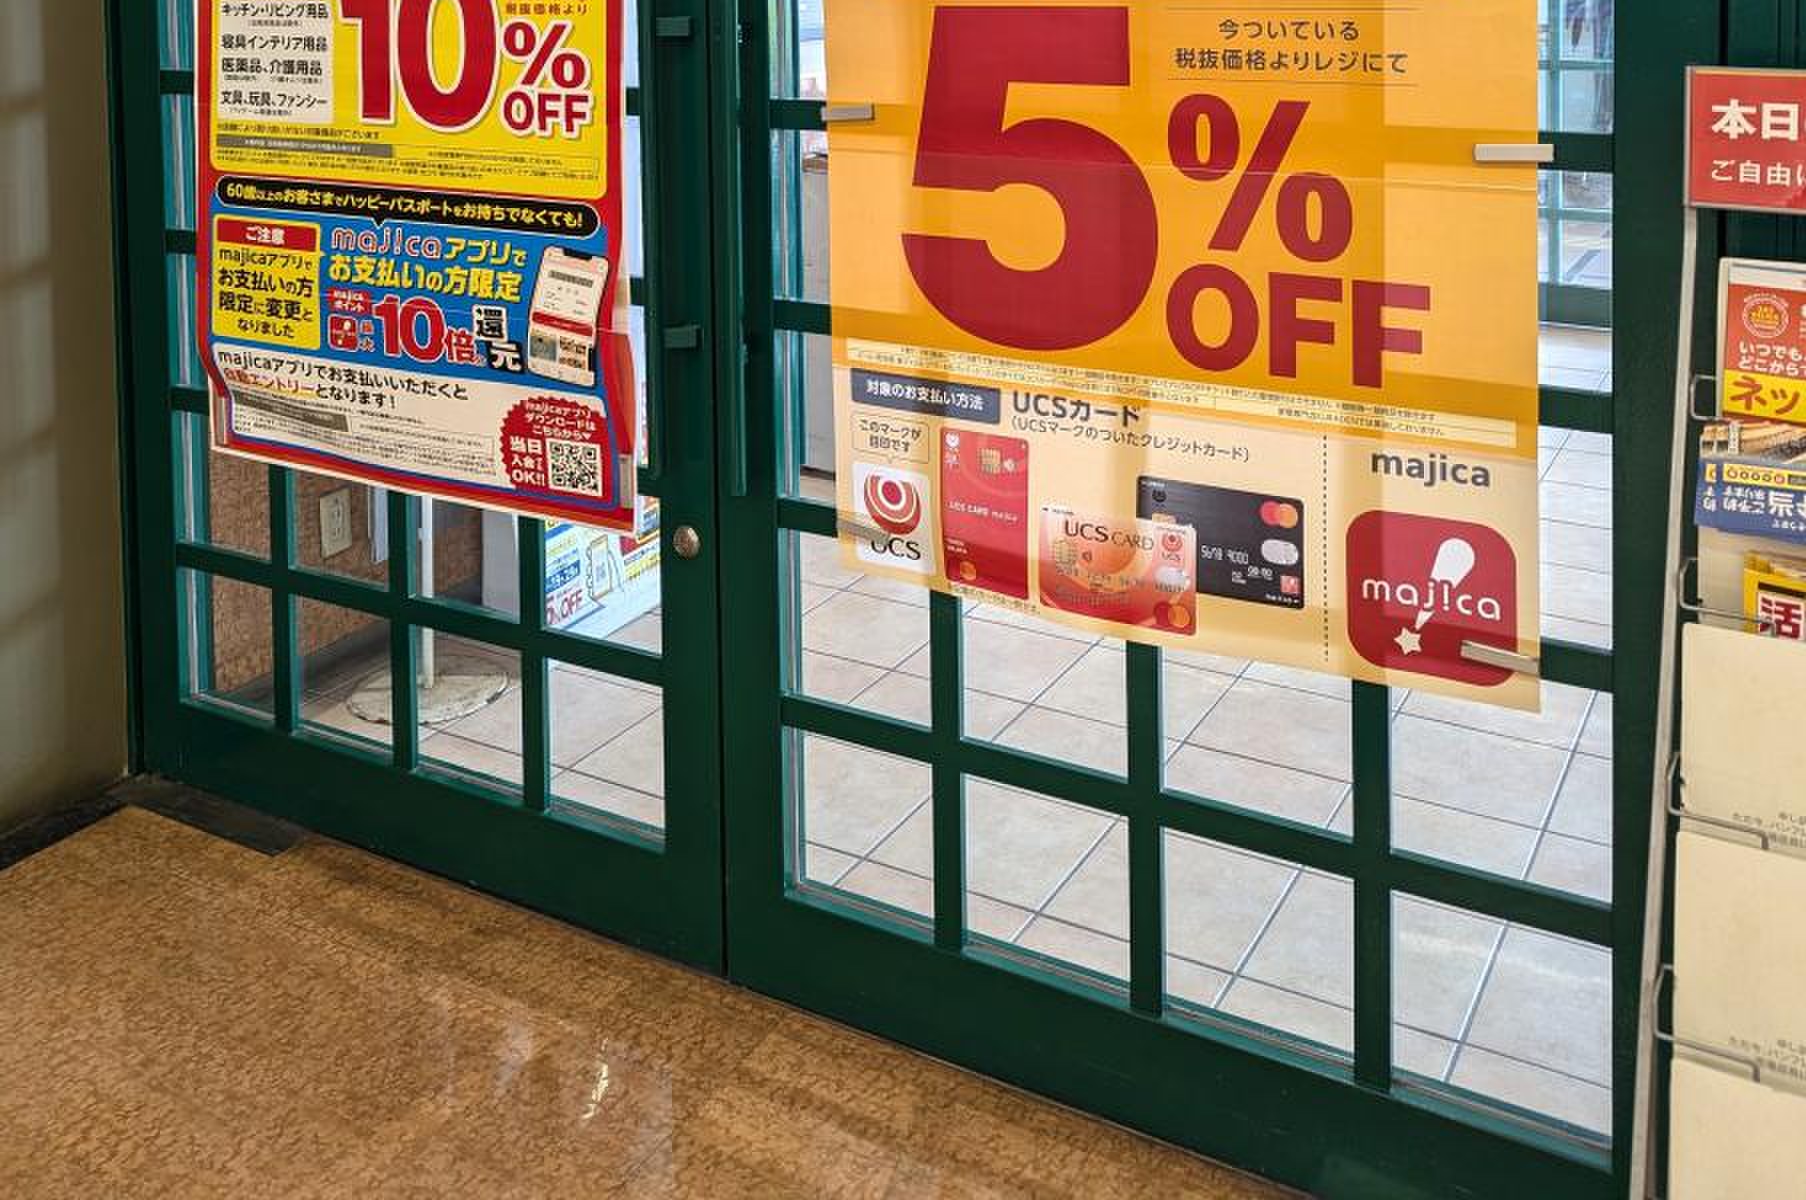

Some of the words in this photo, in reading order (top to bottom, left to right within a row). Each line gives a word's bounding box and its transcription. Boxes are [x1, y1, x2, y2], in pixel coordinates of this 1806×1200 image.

[222, 33, 327, 52] 寝具インテリア用品
[1219, 18, 1360, 42] 今ついている
[503, 22, 587, 90] %
[1174, 48, 1409, 74] 税抜価格よりレジにて
[503, 92, 589, 134] OFF
[1711, 98, 1806, 142] 本日
[901, 6, 1158, 351] 5
[1168, 92, 1353, 263] %
[245, 225, 285, 246] ご注意
[219, 248, 312, 270] majicaアプリで
[218, 267, 315, 297] お支払いの方
[329, 253, 523, 302] お支払いの方限定
[219, 291, 313, 322] 限定に変更と
[238, 318, 295, 339] なりました
[473, 306, 523, 373] 還元
[1166, 263, 1431, 390] OFF
[218, 351, 469, 401] majicaアプリでお支払いいただくと
[865, 377, 985, 412] 対象のお支払い方法
[1012, 390, 1142, 427] UCSカード
[511, 436, 542, 454] 当日
[859, 418, 922, 439] このマークが
[869, 436, 912, 453] 目印です
[1371, 449, 1491, 489] majica
[1064, 519, 1109, 543] UCS
[1111, 531, 1154, 551] CARD
